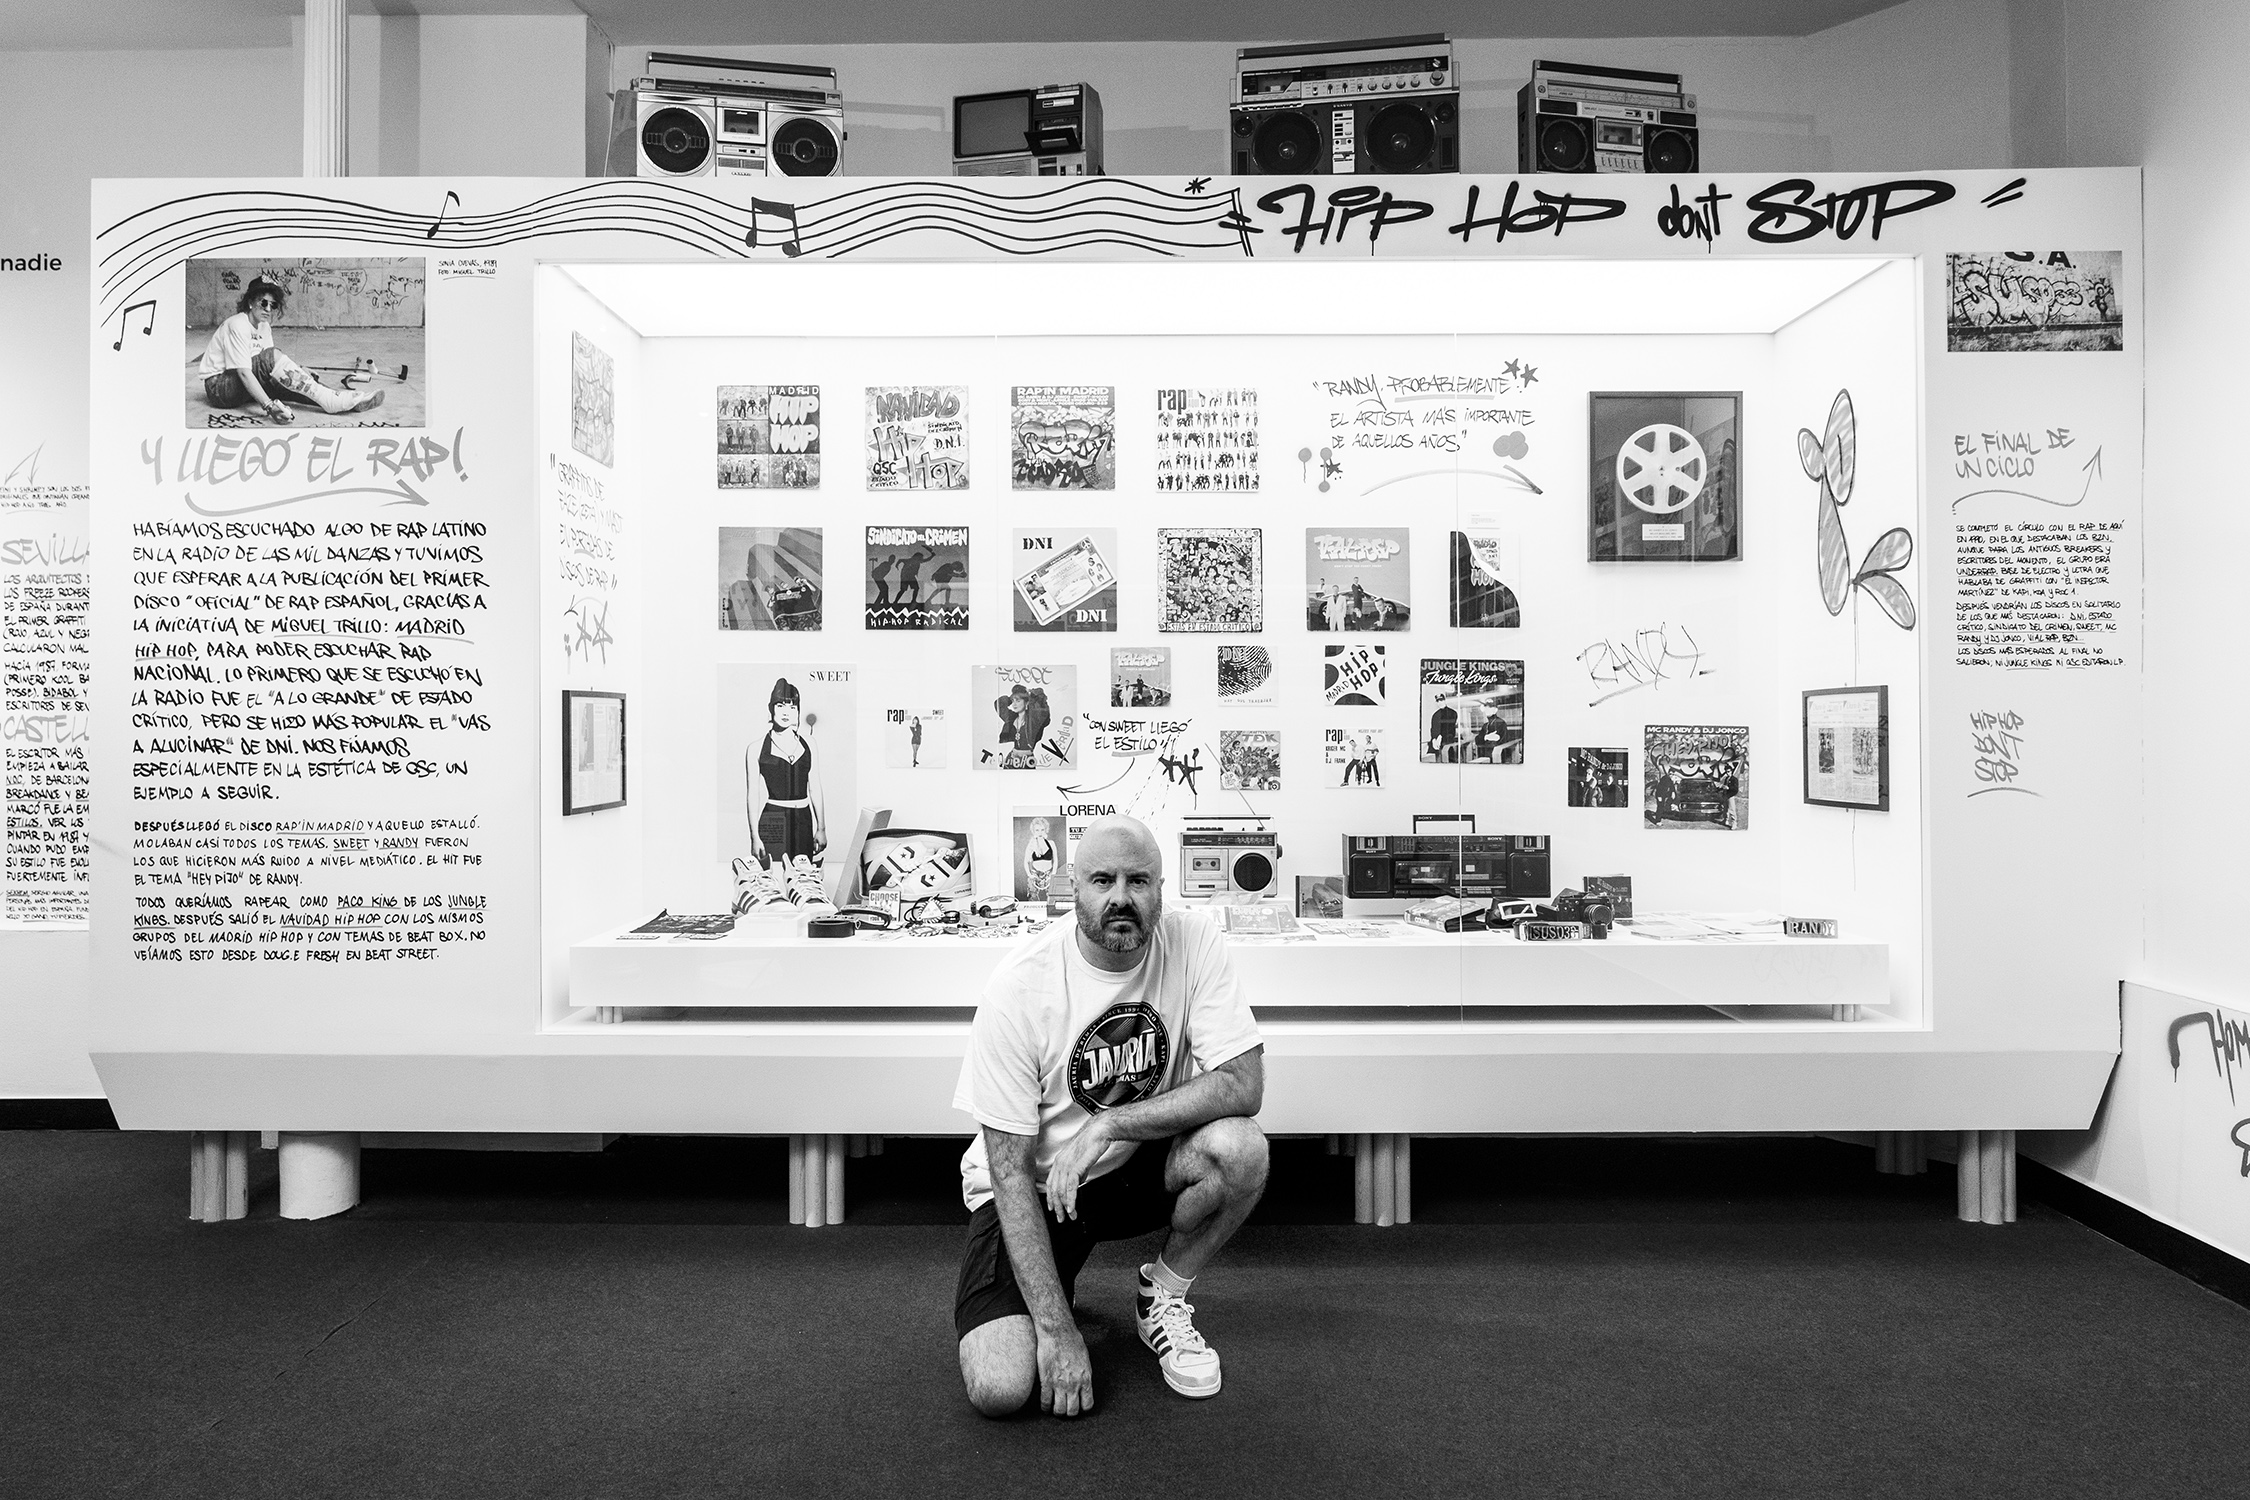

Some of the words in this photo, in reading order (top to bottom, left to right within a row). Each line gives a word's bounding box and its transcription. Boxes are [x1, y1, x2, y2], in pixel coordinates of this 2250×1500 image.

[1449, 181, 1626, 243] HOP
[1746, 178, 1957, 244] STOP
[0, 252, 63, 272] nadie
[768, 386, 820, 395] MADRID
[1059, 387, 1109, 395] MADRID
[769, 394, 820, 425] HIP
[876, 389, 961, 424] NAVIDAD
[1157, 389, 1187, 415] rap
[1330, 412, 1349, 428] EL
[1353, 410, 1415, 427] ARTISTA
[1422, 406, 1457, 425] MÁS
[1463, 407, 1536, 426] IMPORTANTE
[769, 424, 820, 454] HOP
[1331, 435, 1345, 449] DE
[1351, 433, 1414, 449] AQUELLOS
[1954, 434, 1977, 456] EL
[1981, 430, 2042, 456] FINAL
[2046, 427, 2076, 449] DE
[140, 434, 164, 485] Y
[306, 435, 354, 484] EL
[365, 425, 470, 483] RAP!
[872, 461, 897, 476] QSC
[1955, 456, 1982, 479] UN
[1985, 455, 2035, 478] CICLO
[133, 518, 224, 540] HABÍAMOS
[225, 521, 316, 539] ESCUCHADO
[324, 522, 364, 538] ALGO
[369, 522, 393, 538] DE
[396, 521, 428, 540] RAP
[431, 519, 487, 539] LATINO
[1955, 524, 1966, 533] SE
[2004, 524, 2014, 533] EL
[2048, 524, 2064, 532] CON
[2067, 523, 2077, 532] EL
[2078, 522, 2096, 532] RAP
[2098, 522, 2108, 531] DE
[867, 527, 917, 546] SINDICATO
[924, 527, 968, 547] CRIMEN
[1022, 536, 1054, 550] DNI
[3, 574, 22, 585] LOS
[25, 572, 82, 585] ARQUITECTOS
[133, 571, 168, 587] QUE
[172, 570, 242, 588] ESPERAR
[246, 572, 258, 588] A
[259, 572, 278, 588] LA
[280, 567, 384, 589] PUBLICACIÓN
[389, 569, 418, 587] DEL
[422, 569, 491, 588] PRIMER
[3, 601, 15, 612] DE
[19, 599, 51, 613] ESPAÑA
[3, 615, 17, 627] EL
[18, 615, 50, 627] PRIMER
[53, 614, 85, 626] GRAFFITI
[915, 617, 963, 626] RADICAL
[1076, 609, 1108, 624] DNI
[3, 642, 65, 654] CALCULARON
[69, 643, 90, 654] MAL
[1338, 650, 1370, 679] HIP
[1421, 661, 1467, 671] JUNGLE
[1469, 662, 1506, 672] KINGS
[809, 670, 851, 682] SWEET
[1349, 662, 1380, 692] HOP
[1325, 680, 1351, 703] MADRID
[887, 708, 905, 725] rap
[1969, 709, 1998, 732] HIP
[1997, 709, 2025, 731] HOP
[1107, 719, 1147, 733] SWEET
[1094, 737, 1110, 750] EL
[1241, 733, 1279, 745] TDK
[1325, 728, 1344, 745] rap
[1974, 755, 2019, 784] STOP
[5, 787, 61, 802] BREAKDANCE
[64, 790, 71, 799] Y
[1059, 804, 1117, 817] LORENA
[133, 855, 156, 867] LOS
[159, 855, 180, 867] QUE
[185, 854, 237, 868] HICIERON
[240, 852, 266, 867] MÁS
[270, 854, 301, 867] RUIDO
[306, 857, 314, 867] A
[320, 855, 355, 868] NIVEL
[426, 854, 439, 867] EL
[442, 853, 459, 865] HIT
[462, 854, 483, 866] FUE
[870, 892, 899, 902] CHOOSE
[1788, 920, 1836, 936] RANDY
[133, 944, 183, 962] VEÍAMOS
[189, 949, 215, 962] ESTO
[221, 949, 258, 962] DESDE
[306, 949, 340, 964] FRESH
[345, 949, 361, 961] EN
[364, 948, 393, 962] BEAT
[395, 947, 440, 961] STREET.
